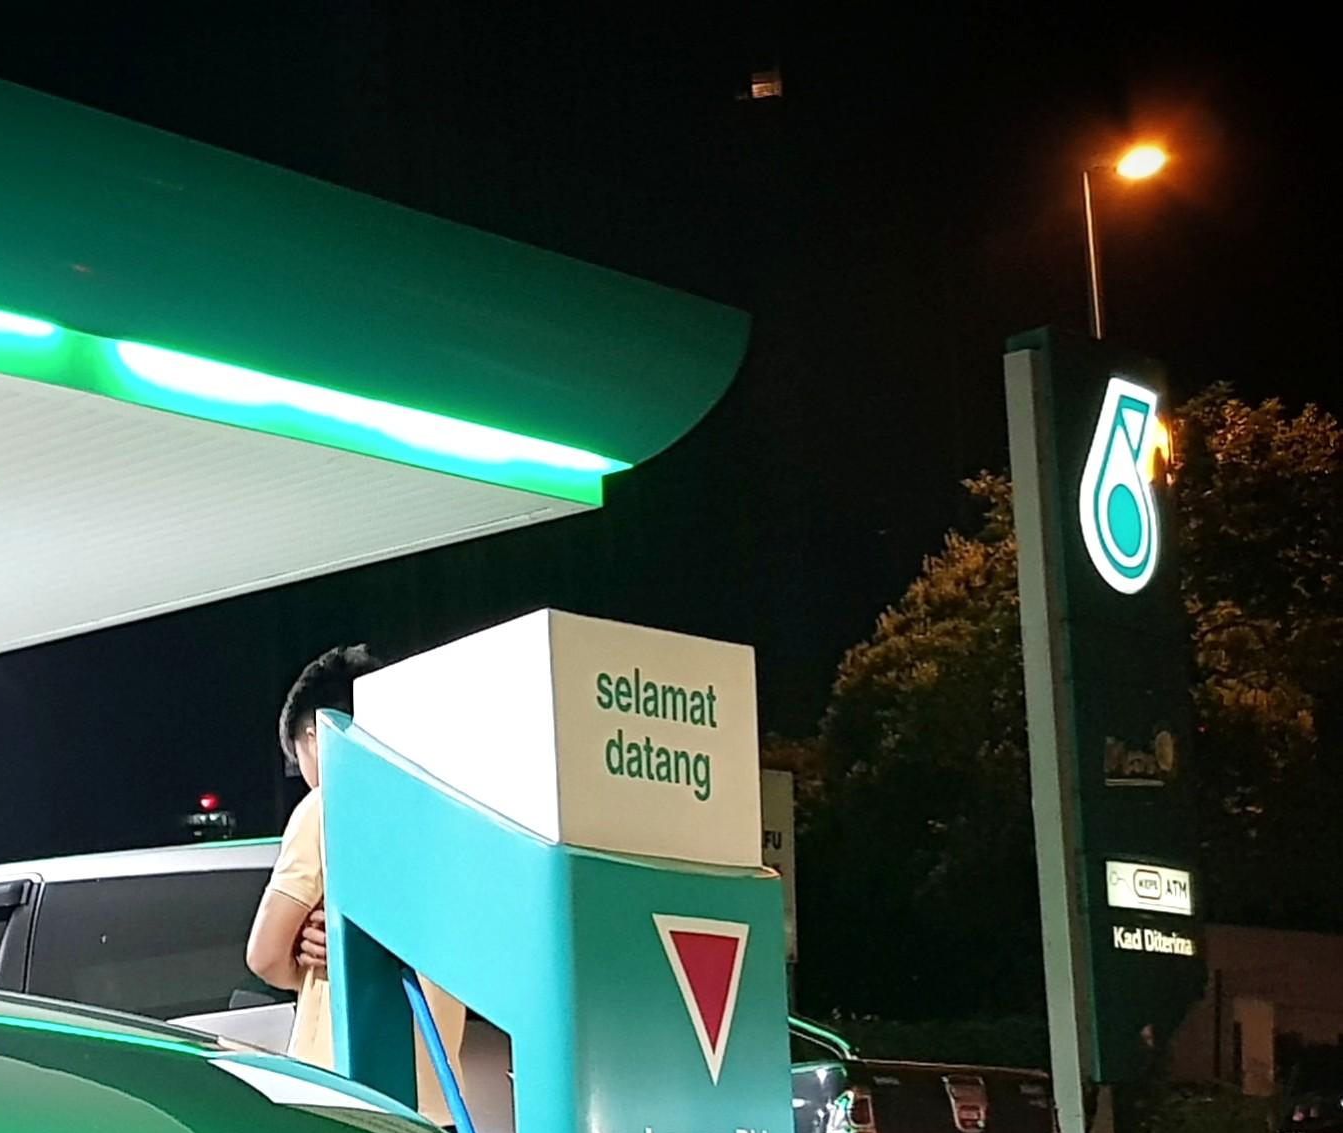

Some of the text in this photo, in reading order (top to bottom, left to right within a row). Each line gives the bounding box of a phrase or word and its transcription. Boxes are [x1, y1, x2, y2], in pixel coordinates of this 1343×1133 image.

[596, 667, 718, 729] selamat
[605, 728, 712, 802] datang
[1164, 878, 1188, 900] ATM
[1112, 925, 1144, 951] Kad
